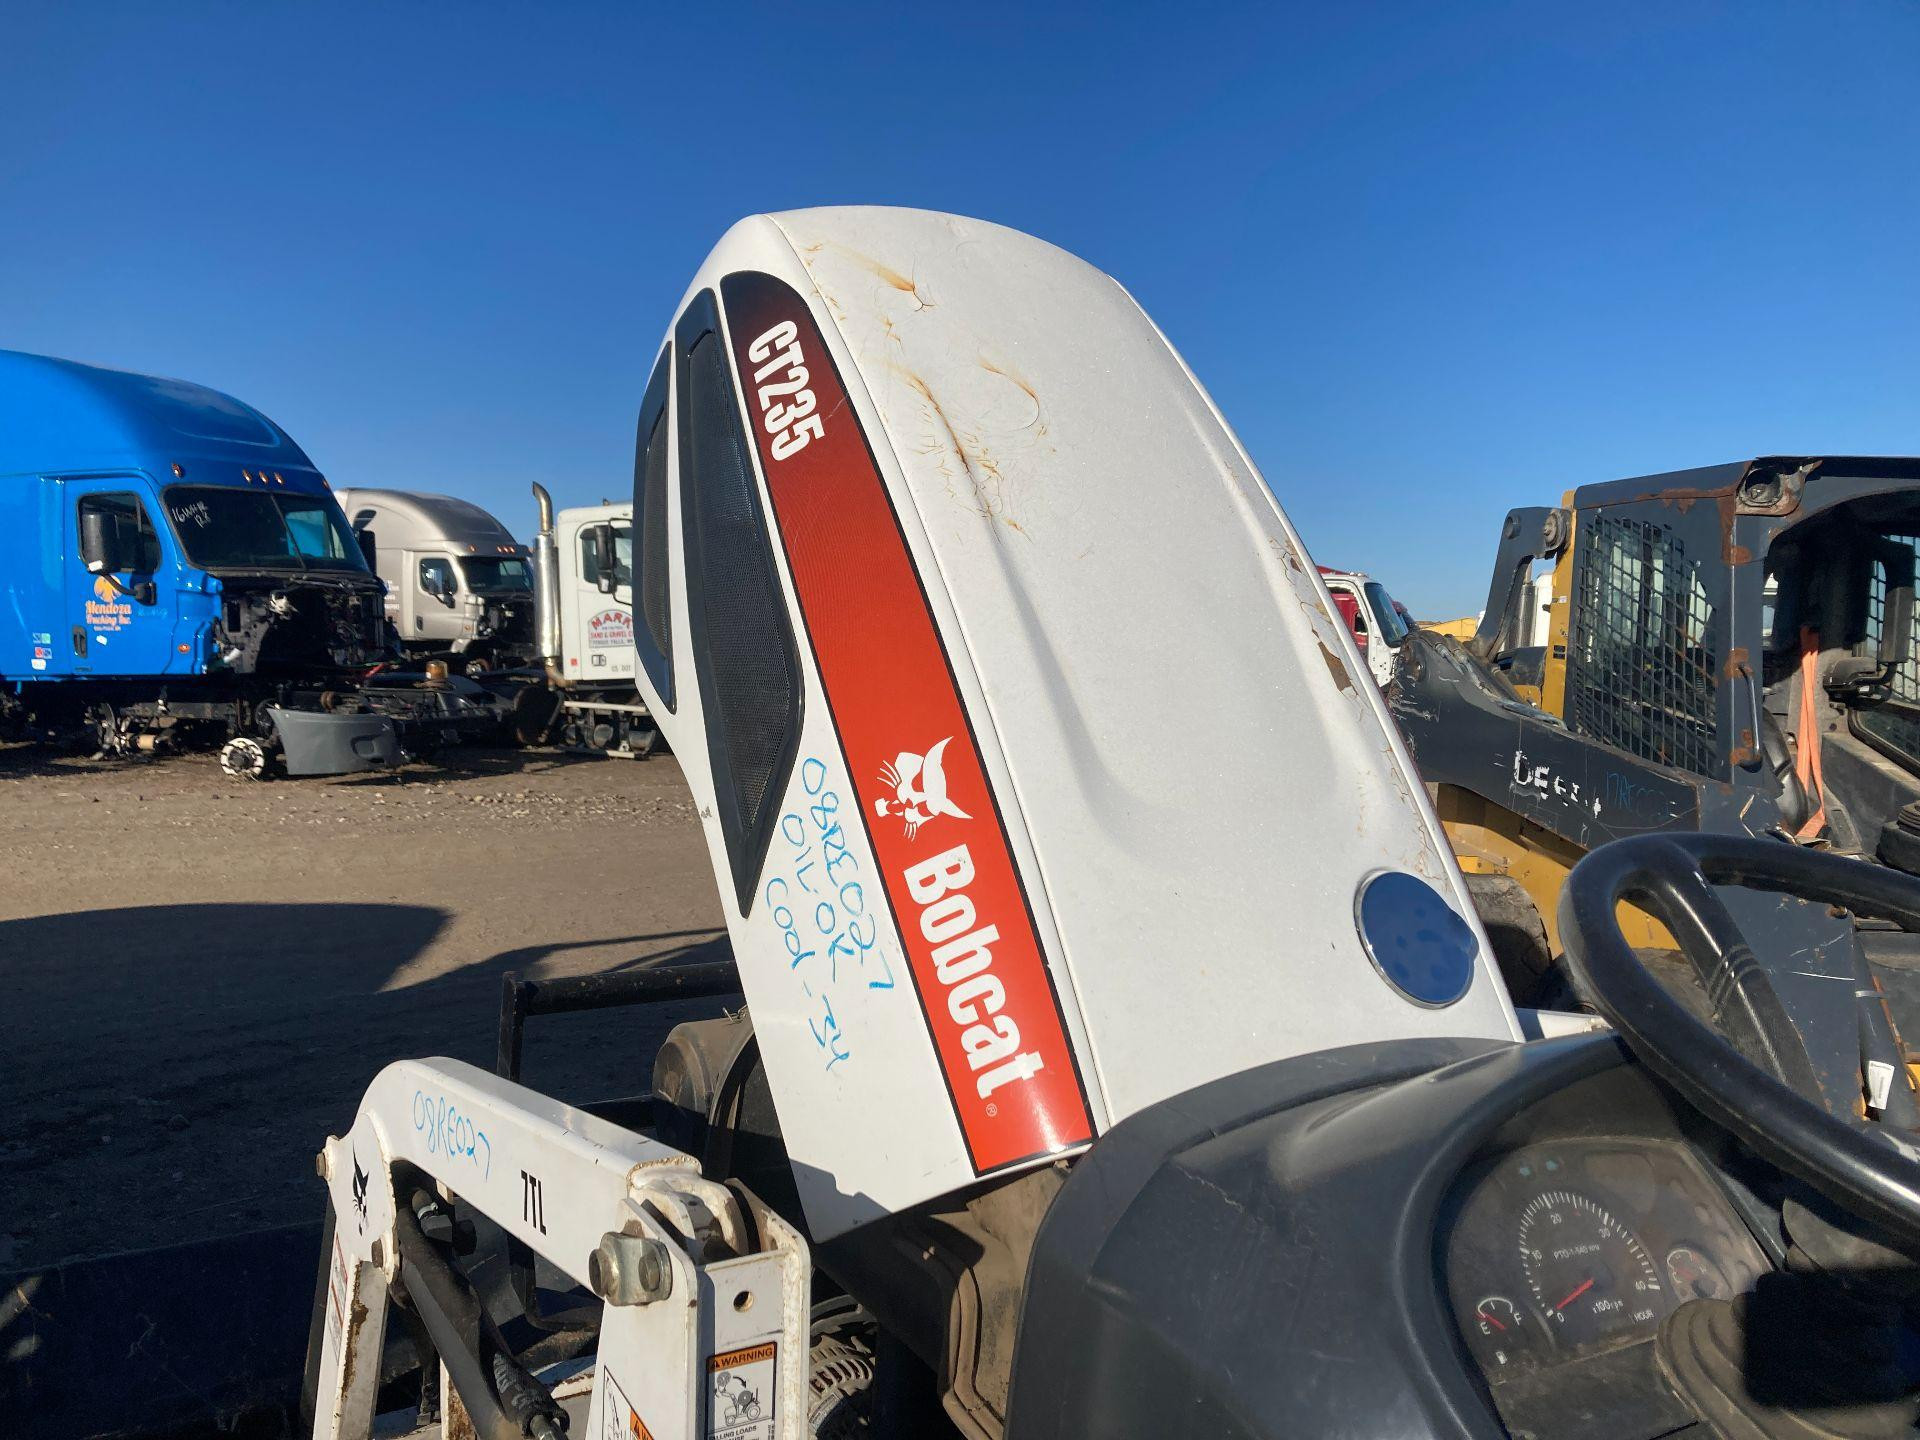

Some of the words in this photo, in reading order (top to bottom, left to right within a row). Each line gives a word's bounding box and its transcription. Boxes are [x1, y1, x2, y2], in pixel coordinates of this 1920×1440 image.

[748, 320, 826, 462] CT235
[902, 843, 1045, 1101] Bobcat
[413, 1090, 491, 1184] 08RE027
[1480, 1321, 1491, 1335] E
[1513, 1311, 1522, 1326] F
[720, 1347, 774, 1368] WARNING
[736, 1425, 757, 1437] LOADS
